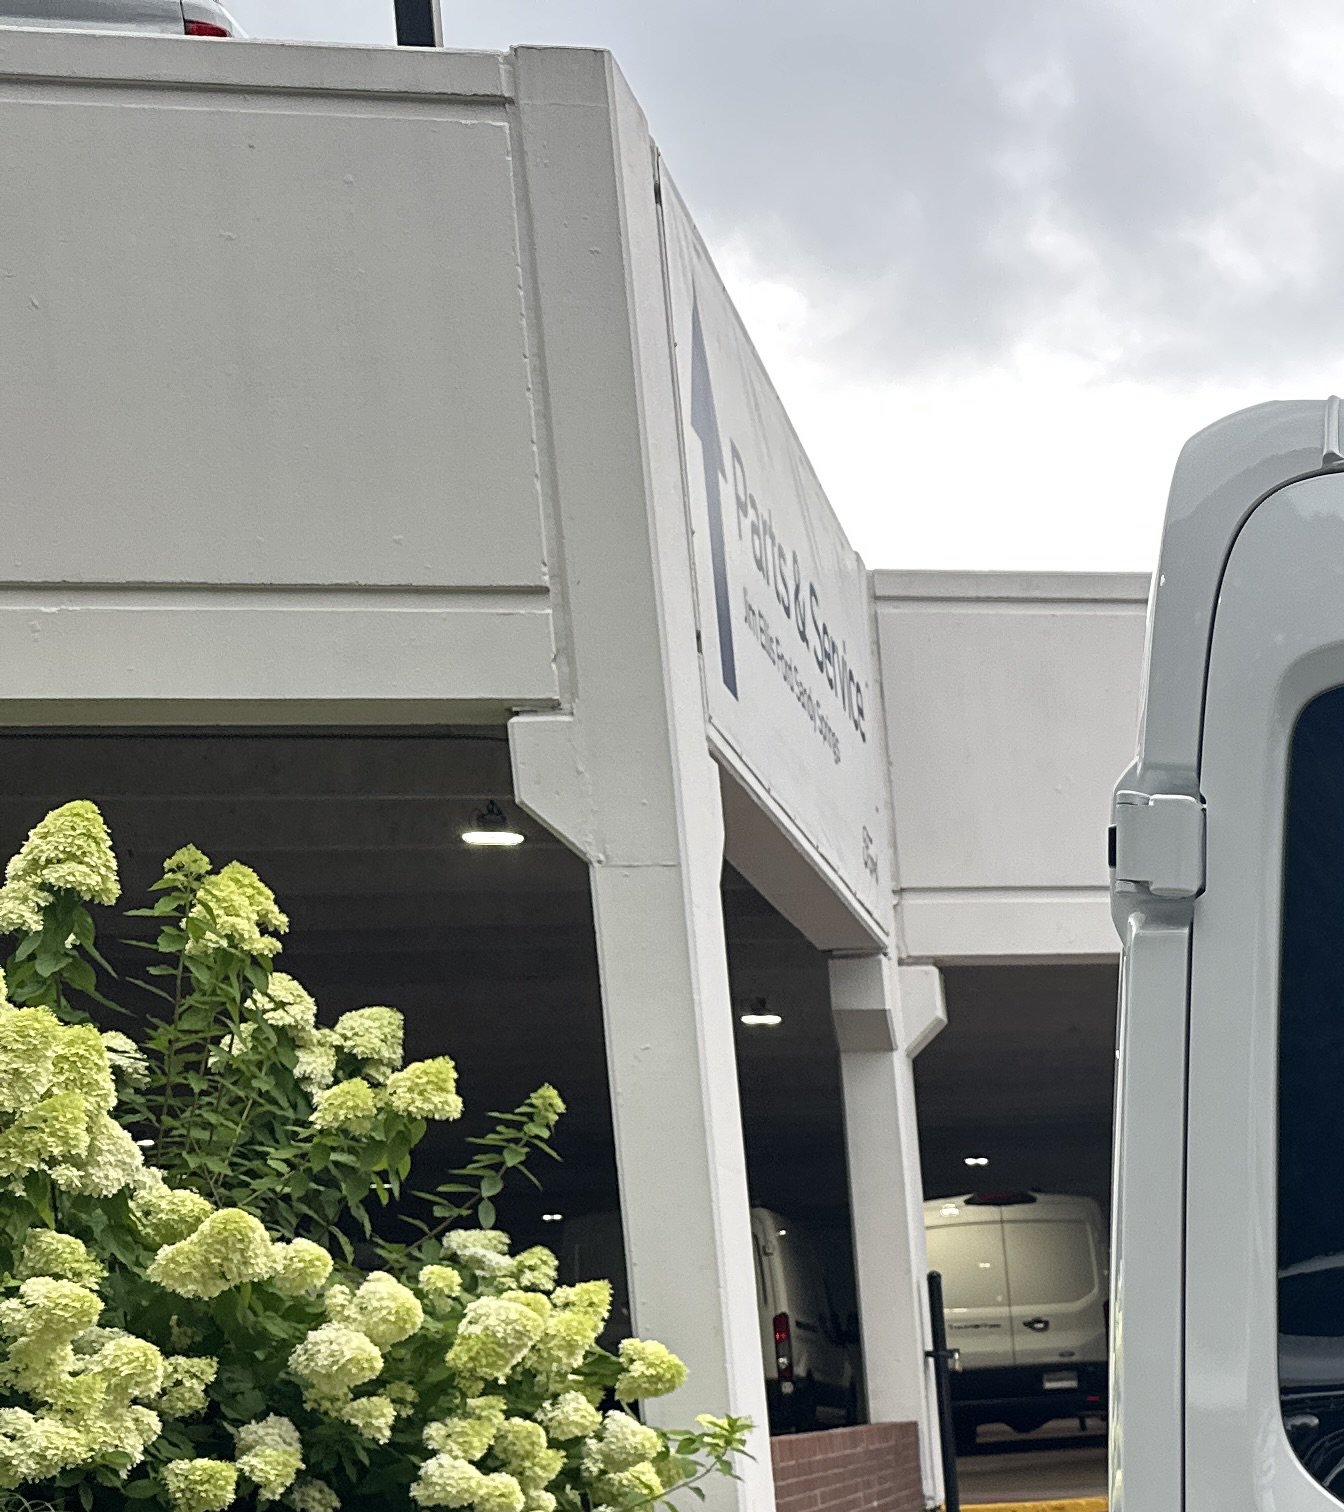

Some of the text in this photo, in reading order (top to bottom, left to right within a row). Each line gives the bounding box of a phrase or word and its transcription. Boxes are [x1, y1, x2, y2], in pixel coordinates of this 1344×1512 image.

[730, 436, 867, 743] Parts & Service
